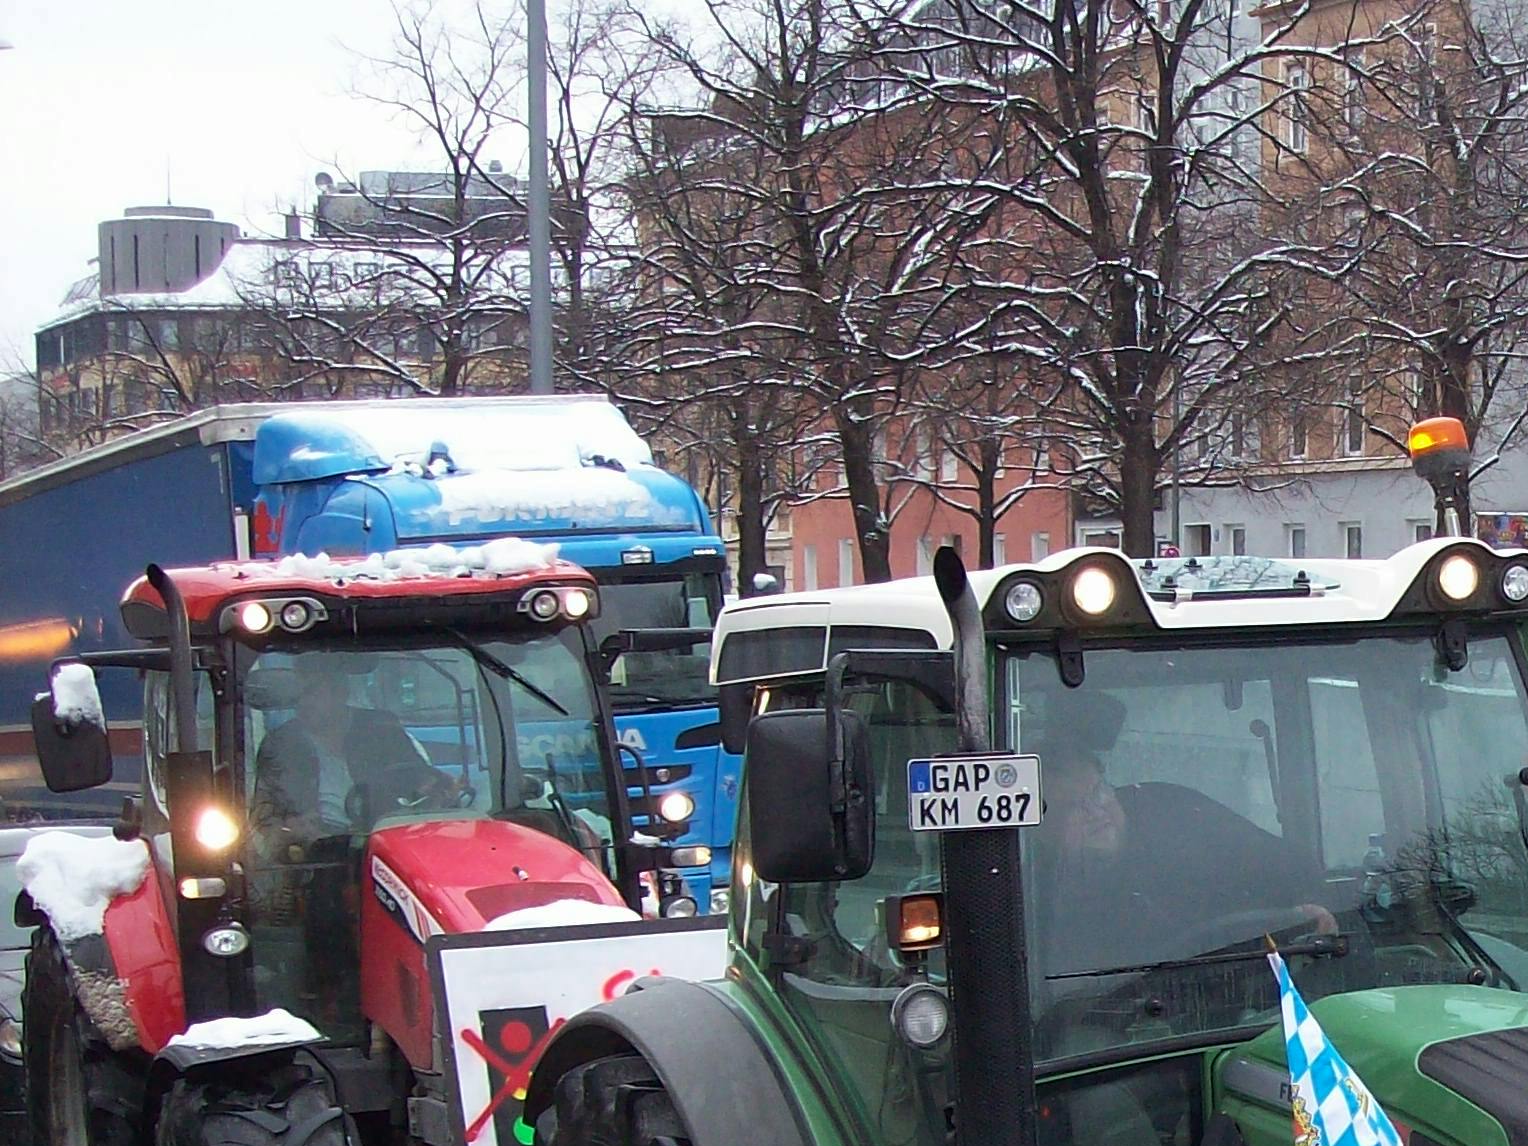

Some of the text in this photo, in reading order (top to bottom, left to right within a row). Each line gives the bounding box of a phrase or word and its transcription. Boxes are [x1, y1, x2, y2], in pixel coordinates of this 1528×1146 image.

[931, 763, 991, 794] GAP
[919, 793, 1031, 827] KM 687
